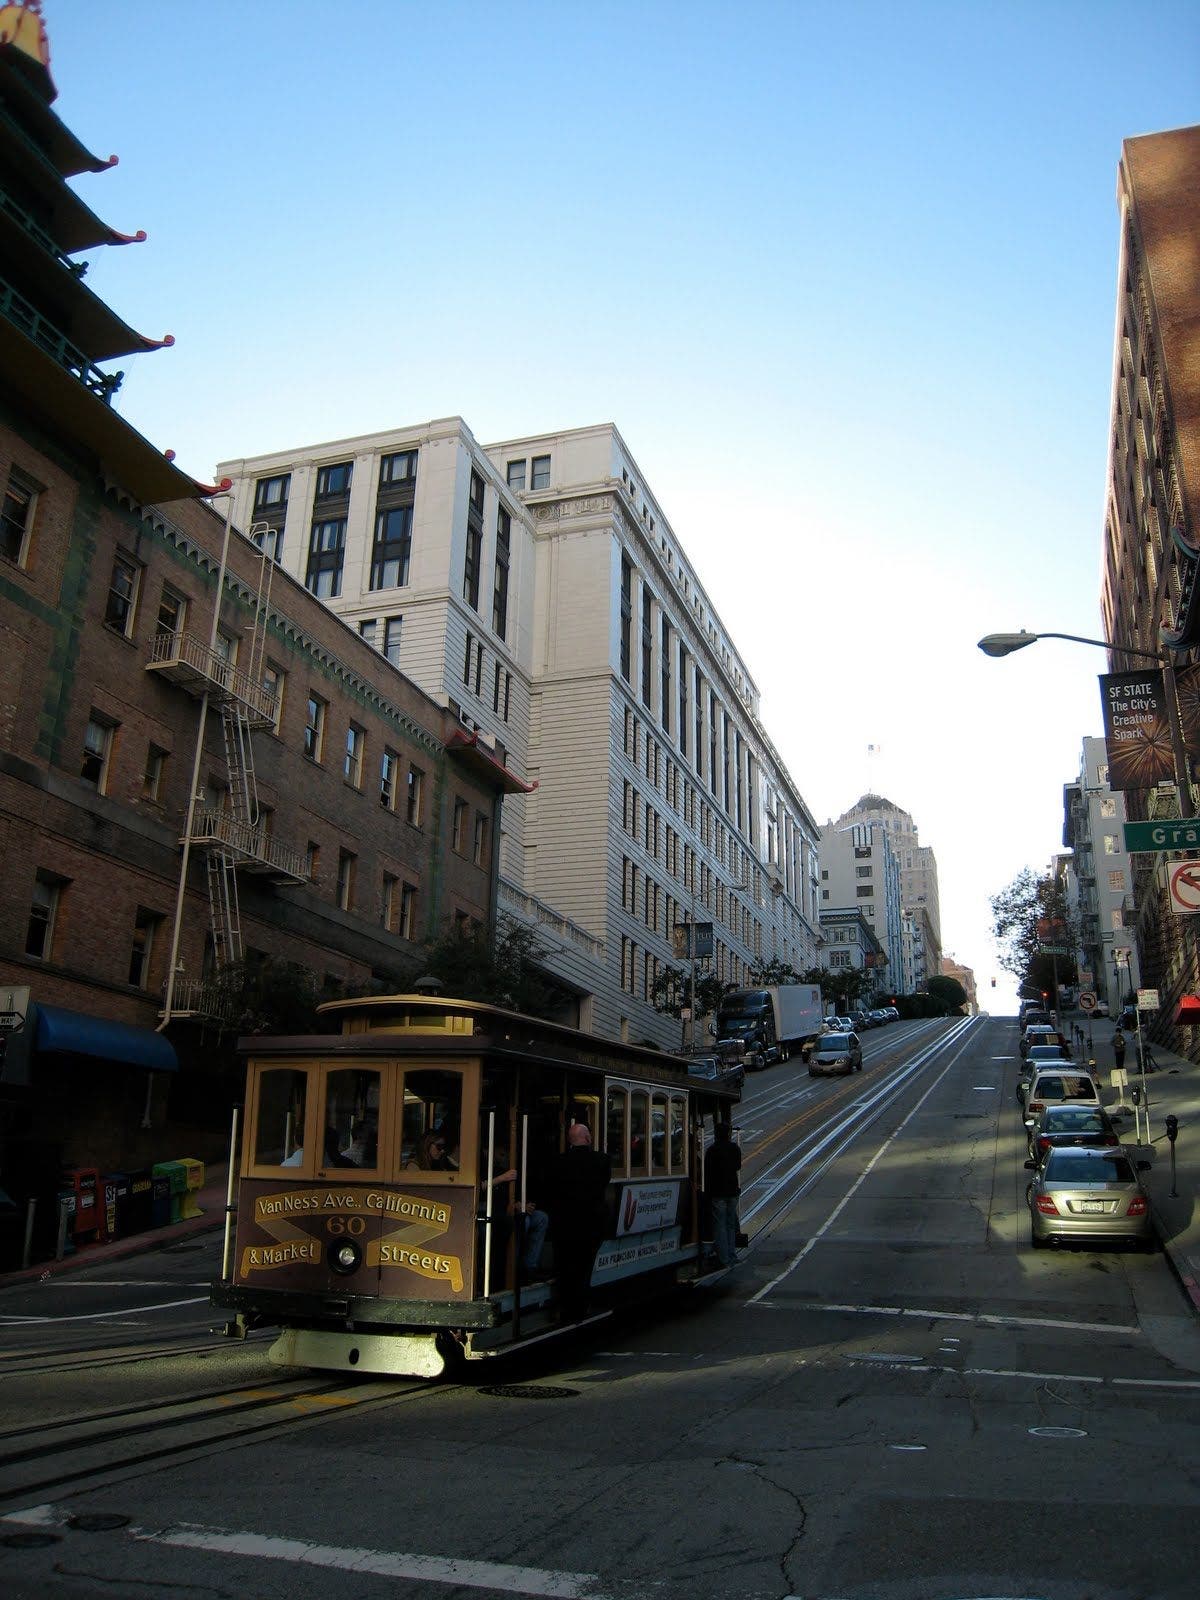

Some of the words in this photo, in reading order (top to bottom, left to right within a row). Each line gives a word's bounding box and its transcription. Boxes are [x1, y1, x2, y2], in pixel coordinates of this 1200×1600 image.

[1110, 686, 1121, 698] SF
[1124, 683, 1152, 697] STATE
[1111, 701, 1128, 712] The
[1131, 698, 1156, 711] City's
[1113, 713, 1153, 726] Creative
[1114, 728, 1143, 741] Spark
[366, 1193, 447, 1222] California
[326, 1216, 366, 1234] 60
[250, 1250, 260, 1264] &
[262, 1243, 314, 1265] Market
[380, 1245, 451, 1274] Streets
